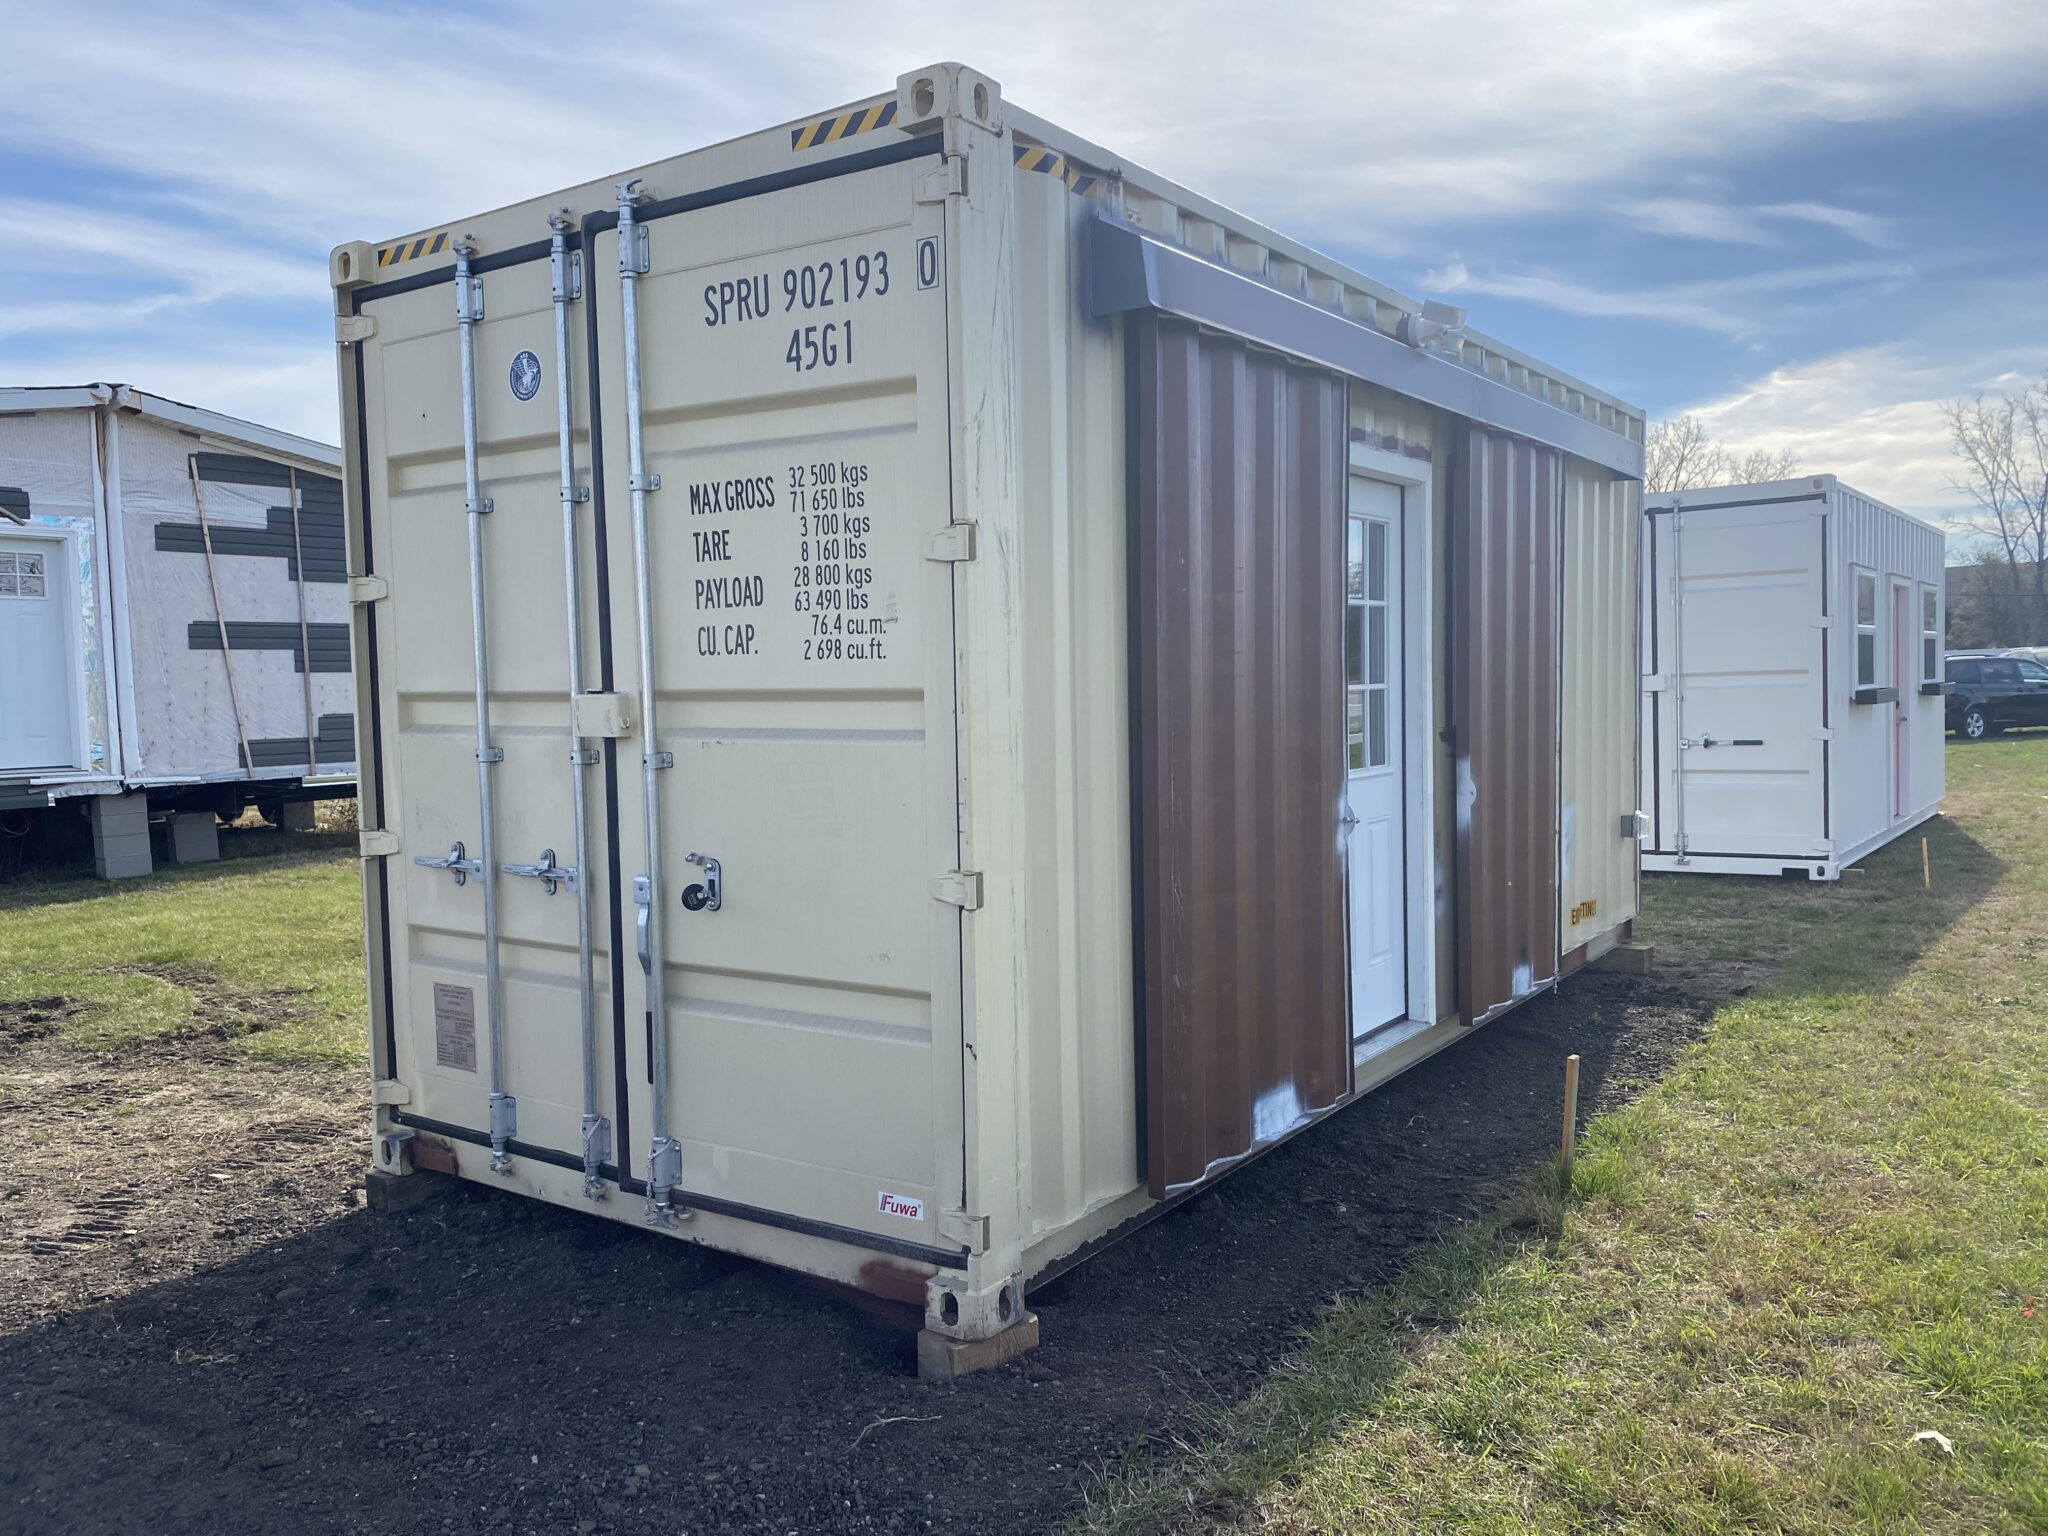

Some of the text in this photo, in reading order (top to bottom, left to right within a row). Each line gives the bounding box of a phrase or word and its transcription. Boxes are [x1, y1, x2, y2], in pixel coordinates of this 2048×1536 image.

[704, 240, 936, 327] SPRU 902193 0
[786, 320, 852, 372] 45G1
[788, 461, 868, 488] 32 500 kgs
[689, 476, 775, 515] MAX GROSS
[790, 487, 865, 512] 71 650 lbs
[800, 512, 871, 538] 3 700 kgs
[693, 529, 731, 562] TARE
[801, 537, 867, 562] 8 160 lbs
[794, 562, 872, 589] 28 800 kgs
[695, 575, 764, 610] PAYLOAD
[794, 588, 869, 611] 63 490 lbs
[812, 613, 842, 636] 76.4
[697, 624, 759, 656] CU. CAP.
[804, 637, 887, 660] 2 698 cu.ft.
[880, 1193, 918, 1217] Fuwa
